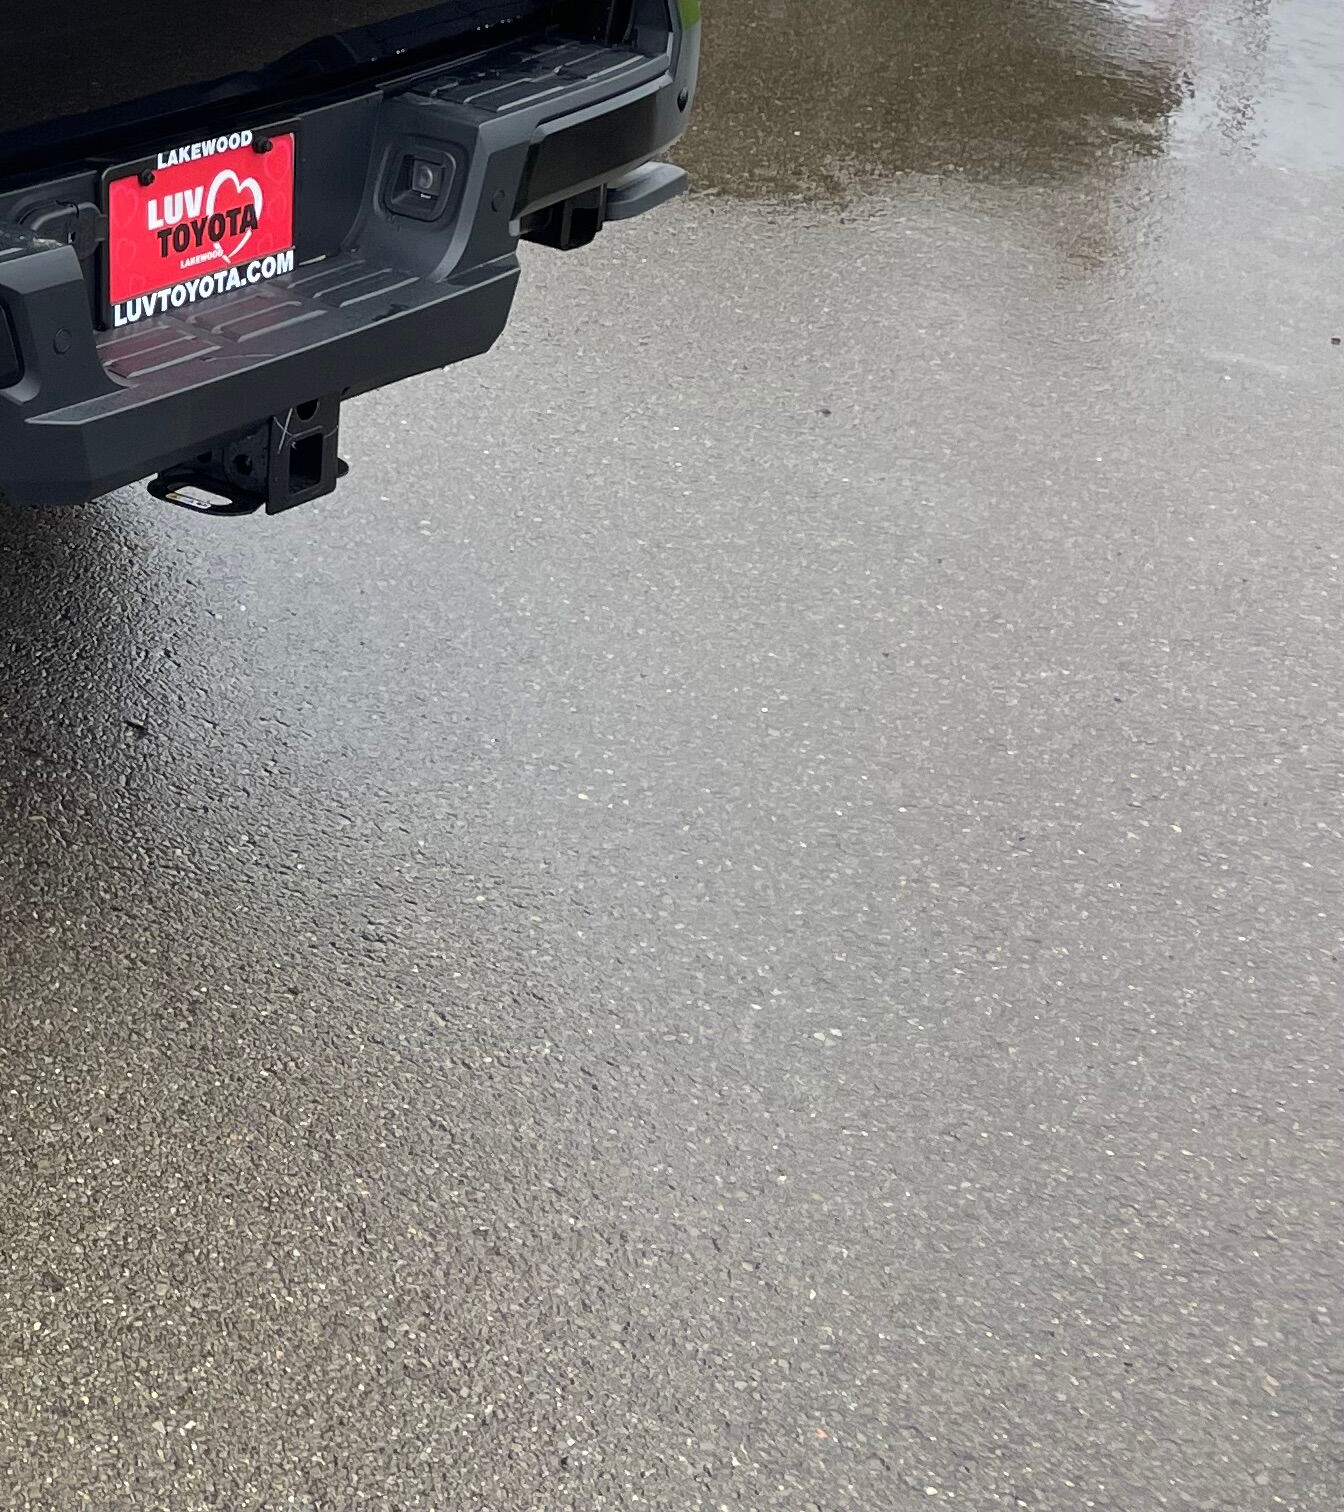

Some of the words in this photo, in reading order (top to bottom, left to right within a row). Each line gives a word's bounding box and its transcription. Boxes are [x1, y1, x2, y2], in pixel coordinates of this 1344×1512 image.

[157, 130, 253, 169] LAKEWOOD
[147, 185, 204, 230] LUV
[157, 204, 258, 258] TOYOTA
[180, 248, 224, 269] LAKEWOOD
[114, 250, 294, 327] LUVTOYOTA.COM
